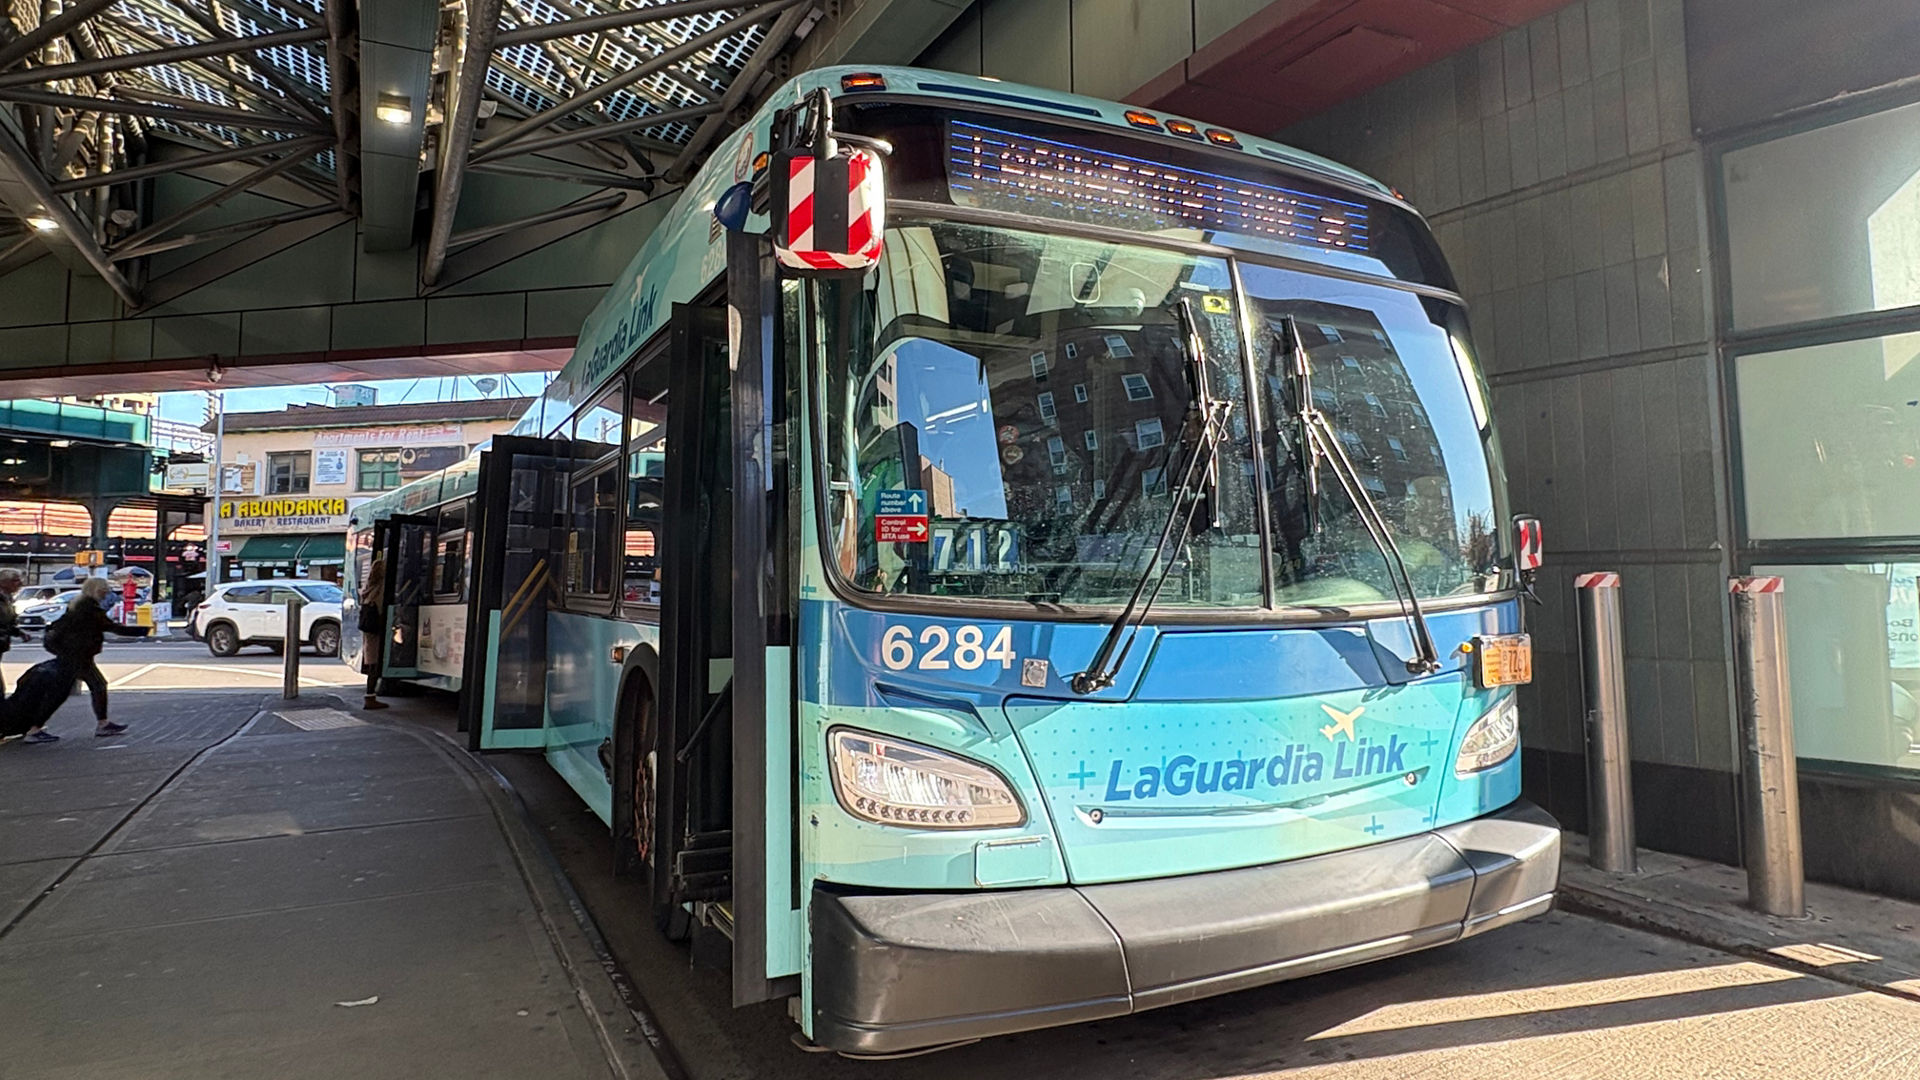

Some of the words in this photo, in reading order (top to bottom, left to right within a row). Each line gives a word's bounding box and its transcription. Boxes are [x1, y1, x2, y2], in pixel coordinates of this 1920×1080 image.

[628, 283, 658, 348] Link
[316, 431, 377, 443] Apartments
[379, 429, 395, 441] For
[399, 427, 425, 441] Rent
[238, 498, 346, 517] ABUNDANCIA
[234, 518, 266, 527] BAKERY
[277, 517, 332, 526] RESTAURANT
[881, 518, 906, 526] Control
[881, 624, 1017, 671] 6284
[1104, 743, 1323, 802] LaGuardia
[1333, 734, 1408, 780] Link
